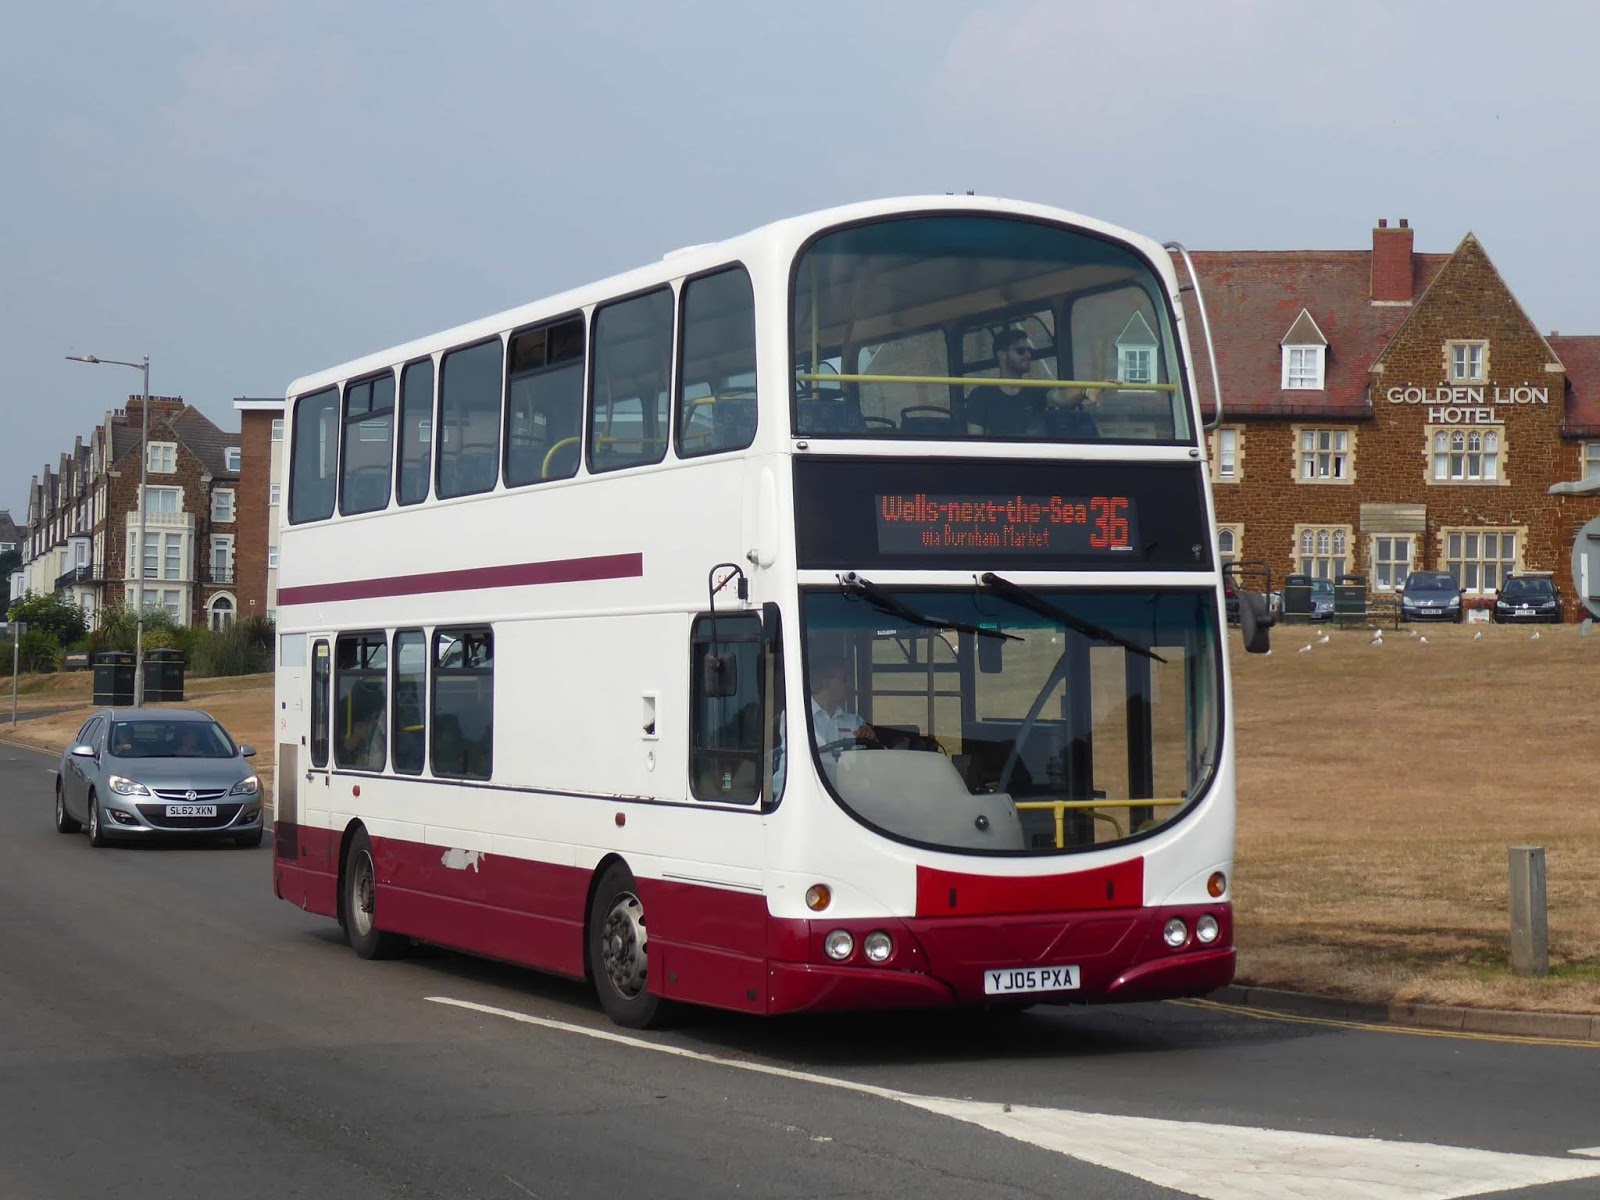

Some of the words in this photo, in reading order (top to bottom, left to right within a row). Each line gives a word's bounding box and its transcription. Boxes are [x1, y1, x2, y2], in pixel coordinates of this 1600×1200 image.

[1386, 386, 1485, 404] GOLDEN
[1494, 387, 1549, 404] LION
[1427, 406, 1506, 424] HOTEL
[881, 493, 1087, 523] Wells-next-the-Sea
[1089, 496, 1129, 548] 36
[921, 526, 940, 546] via
[944, 523, 1000, 546] Burnham
[1003, 523, 1050, 546] Market
[170, 806, 194, 815] SL62
[195, 806, 213, 815] XKN
[992, 971, 1037, 991] YJ05
[1041, 968, 1073, 988] PXA
